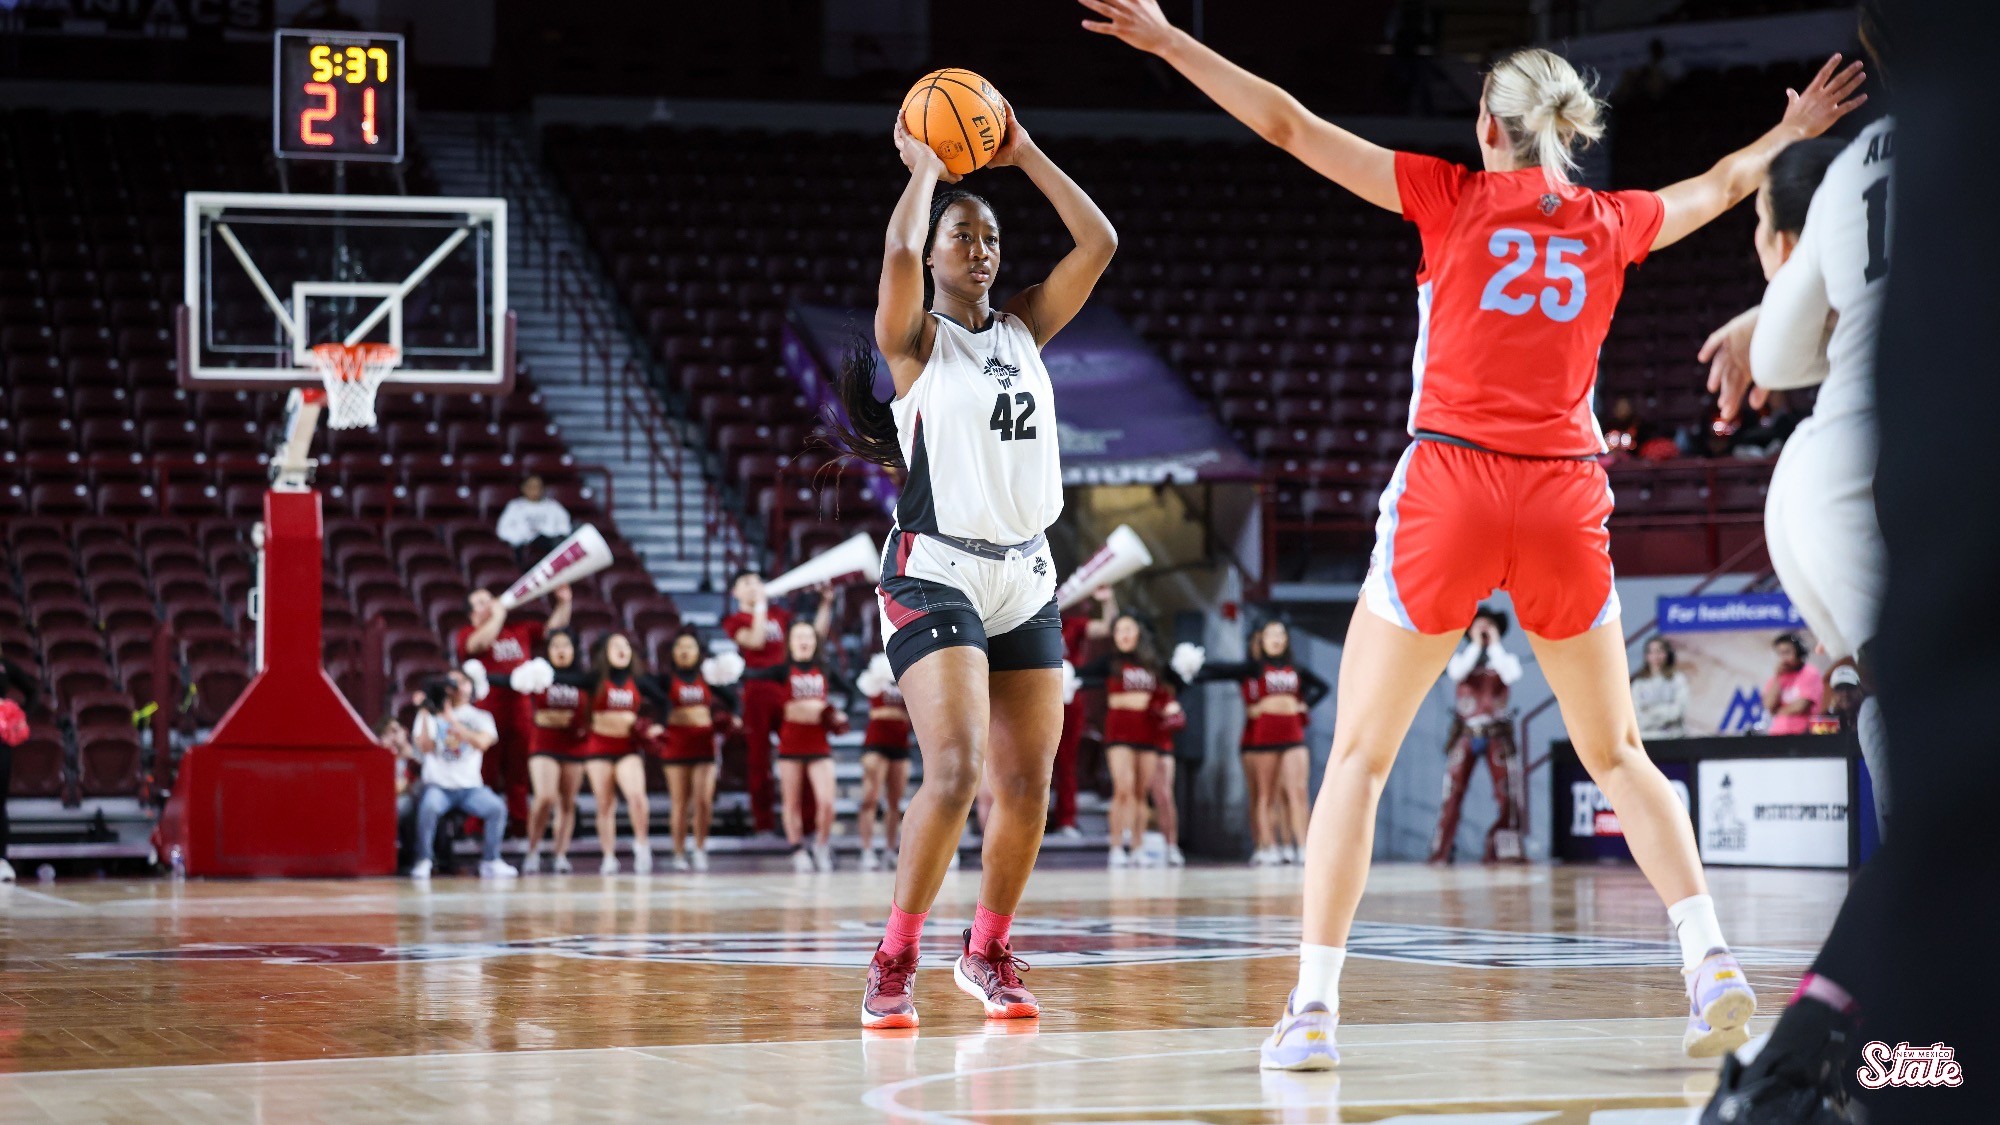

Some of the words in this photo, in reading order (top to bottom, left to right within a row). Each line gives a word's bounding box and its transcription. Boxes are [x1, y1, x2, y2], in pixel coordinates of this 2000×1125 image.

[310, 45, 388, 84] 5:37
[300, 82, 375, 146] 21
[1479, 227, 1589, 323] 25
[989, 391, 1037, 442] 42
[1667, 603, 1696, 624] For
